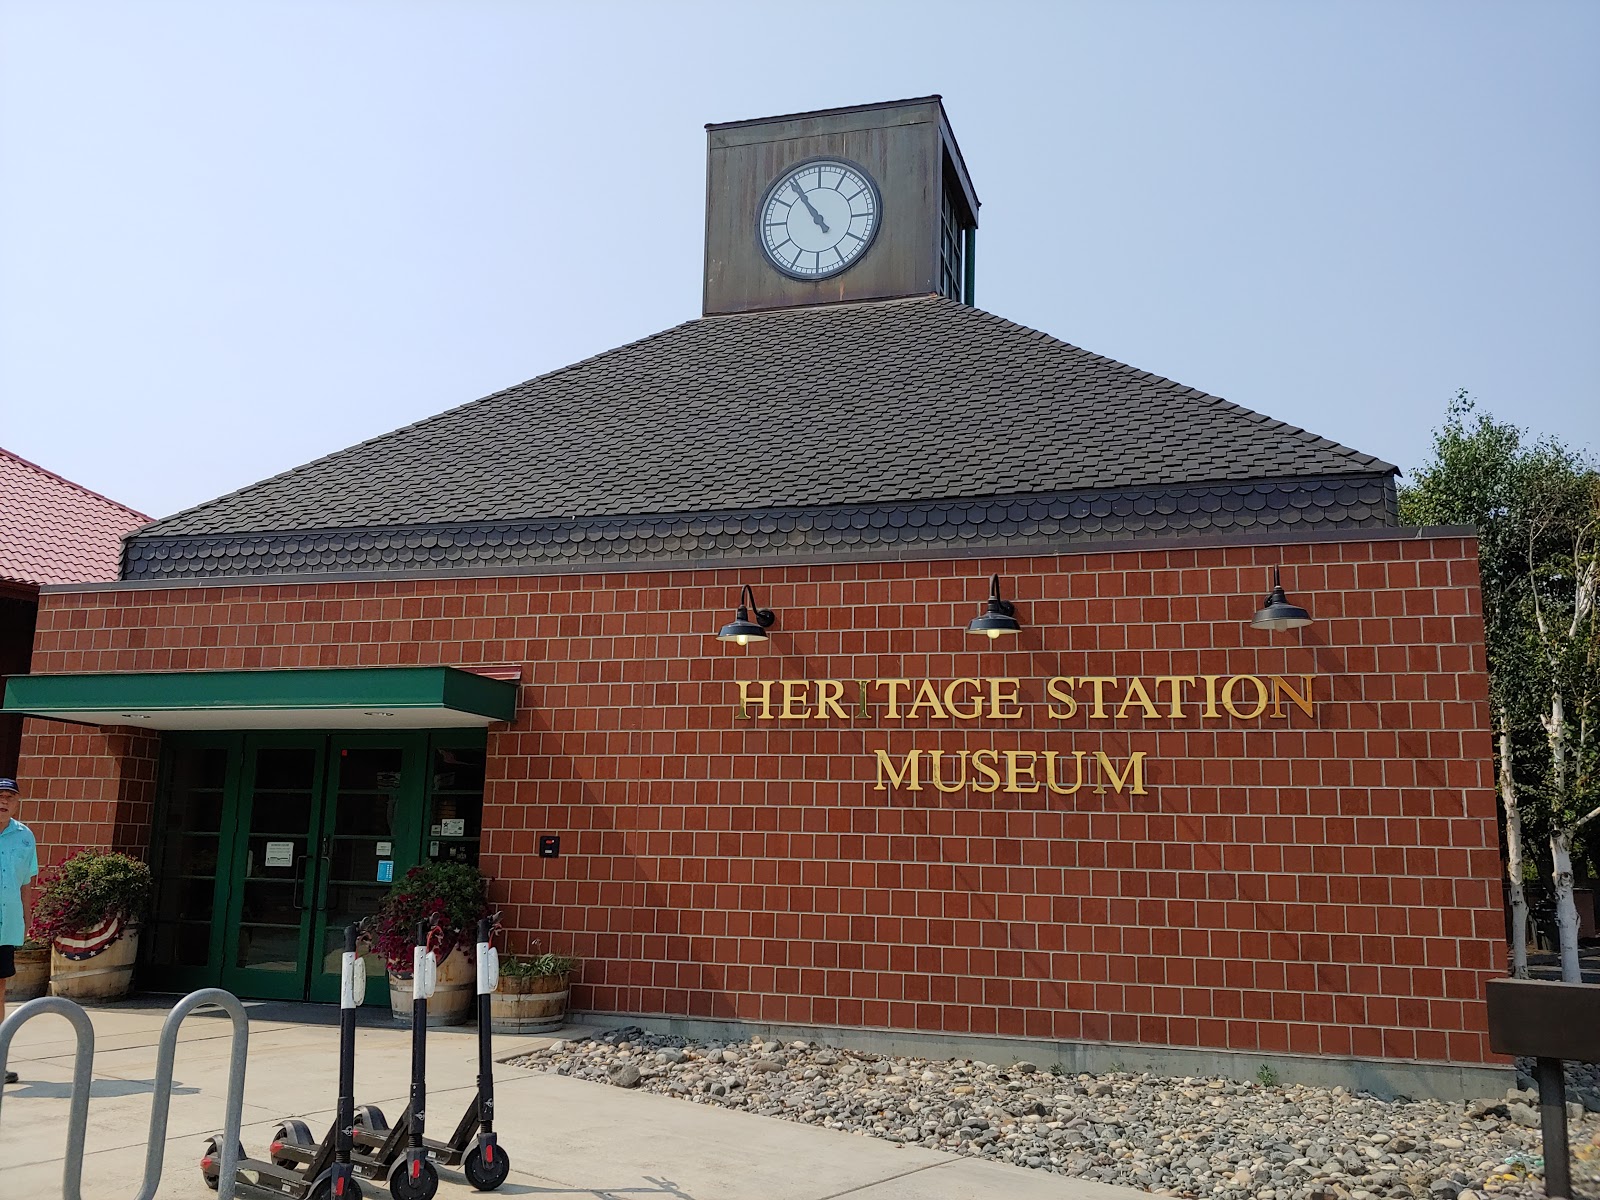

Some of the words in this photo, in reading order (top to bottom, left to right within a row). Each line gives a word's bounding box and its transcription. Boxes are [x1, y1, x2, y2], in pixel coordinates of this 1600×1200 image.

[736, 678, 1022, 720] HERITAGE
[1047, 675, 1317, 719] STATION
[874, 749, 1148, 795] MUSEUM
